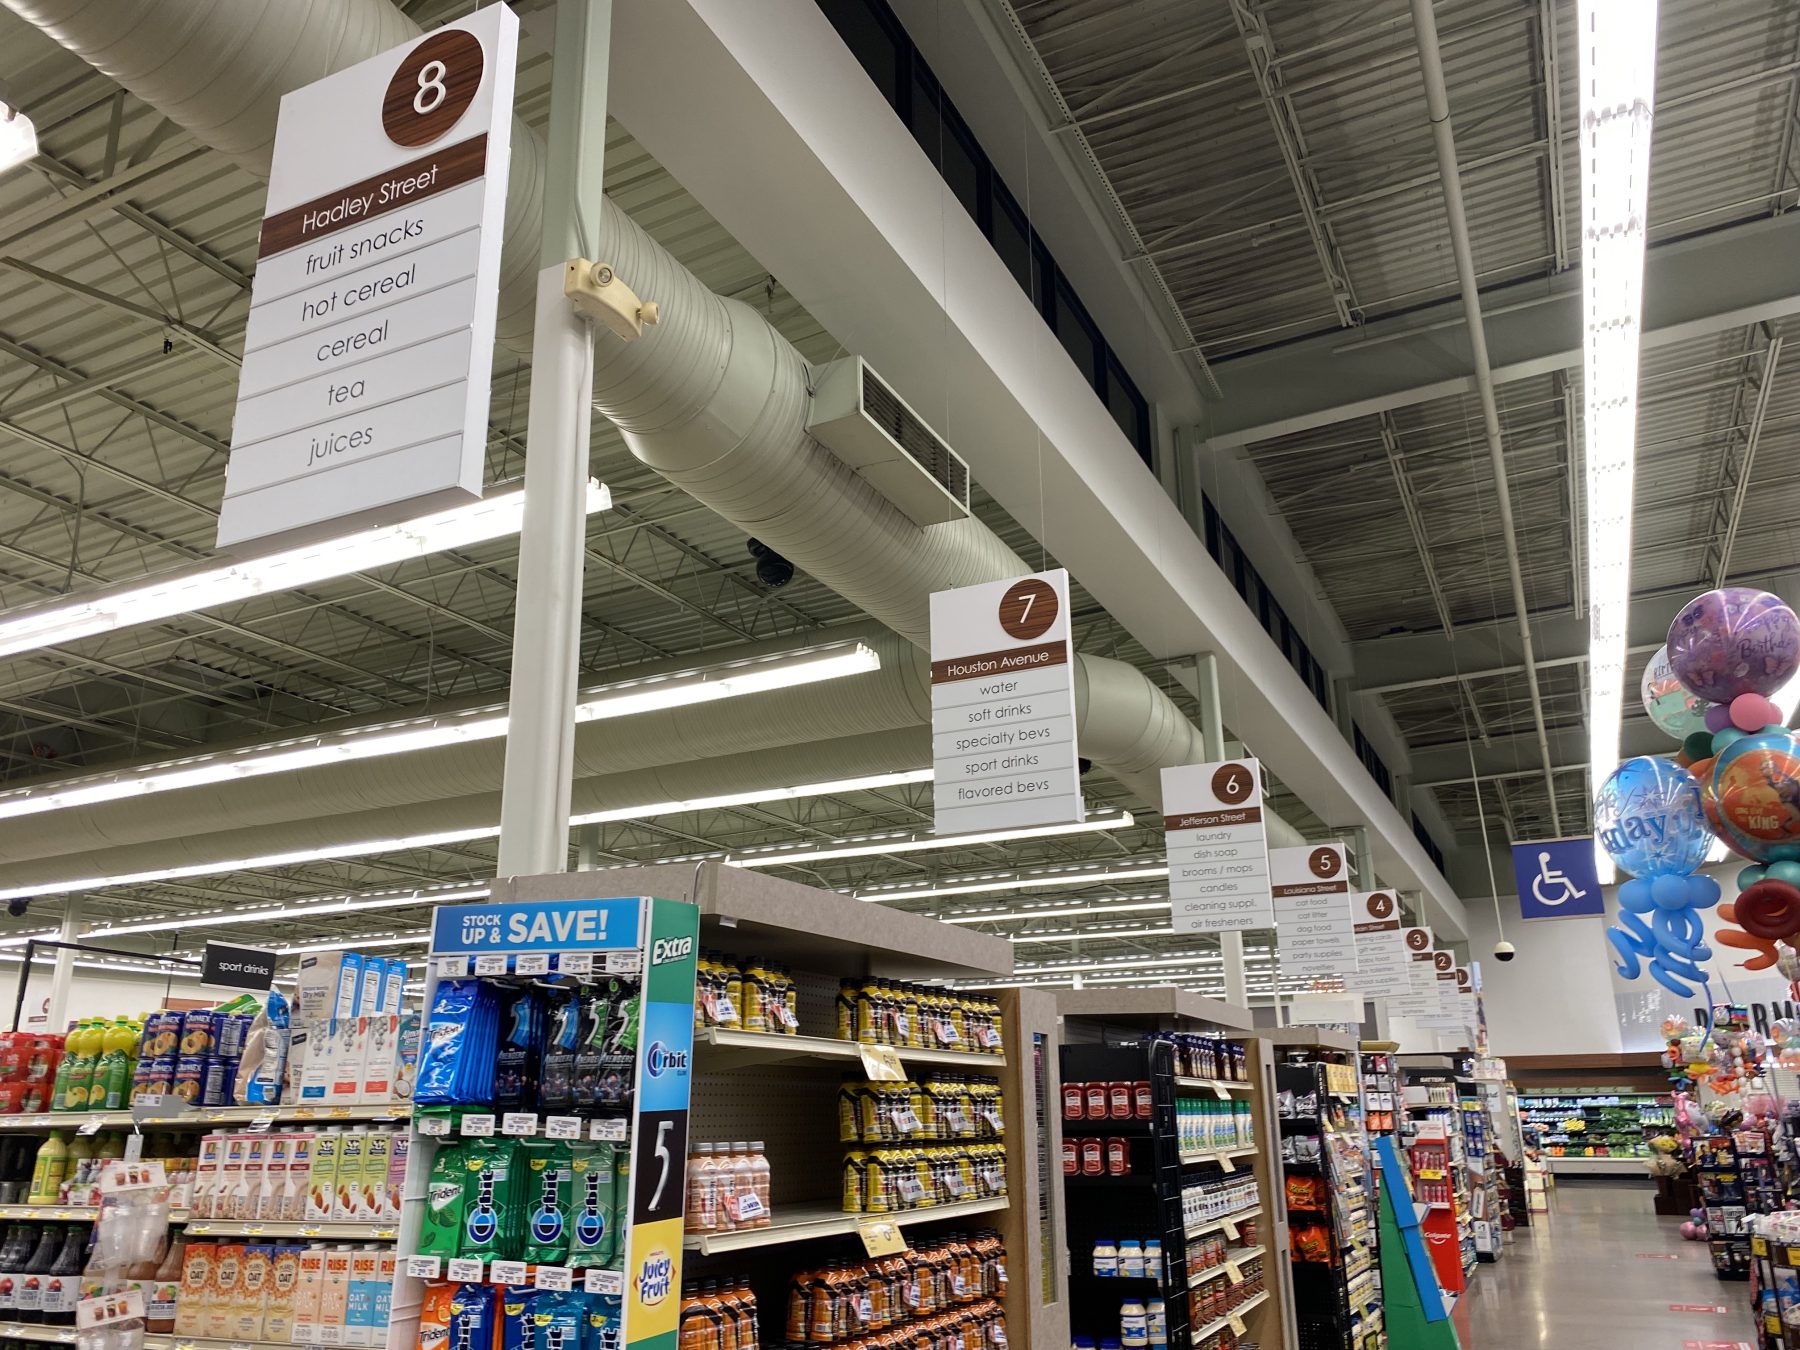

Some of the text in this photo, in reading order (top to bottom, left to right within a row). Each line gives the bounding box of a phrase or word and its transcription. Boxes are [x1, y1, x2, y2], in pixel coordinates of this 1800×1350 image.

[413, 60, 446, 115] 8
[302, 164, 439, 235] Hadley Street
[305, 218, 424, 275] fruit snacks
[302, 264, 416, 322] hot cereal
[316, 319, 389, 362] cereal
[328, 379, 365, 406] tea
[307, 426, 374, 467] juices
[1018, 593, 1037, 624] 7
[947, 650, 1050, 677] Houston Avenue
[979, 680, 1019, 696] water
[968, 703, 1032, 723] soft drinks
[956, 727, 1050, 751] specialty bevs
[965, 753, 1039, 775] sport drinks
[958, 778, 1050, 801] flavored bevs
[1226, 774, 1240, 795] 6
[1179, 813, 1246, 827] Jefferson Street
[1196, 831, 1231, 843] laundry
[1193, 849, 1238, 860] dish soap
[1320, 855, 1331, 871] 5
[1182, 866, 1217, 878] brooms
[1226, 864, 1253, 875] mops
[1199, 882, 1239, 894] candles
[1283, 885, 1337, 895] Louisiana Street
[1184, 901, 1227, 914] cleaning
[1310, 898, 1328, 906] food
[1375, 900, 1385, 912] 4
[463, 914, 501, 927] STOCK
[507, 909, 609, 944] SAVE!
[1191, 918, 1253, 929] air fresheners
[462, 927, 501, 944] UP &
[1297, 924, 1332, 934] dog food
[1292, 939, 1314, 947] paper
[1413, 934, 1422, 945] 3
[652, 936, 692, 966] Extra
[1293, 952, 1312, 960] party
[218, 961, 269, 976] sport drinks
[1438, 956, 1447, 967] 2
[647, 1041, 687, 1079] Orbit
[649, 1121, 673, 1211] 5
[428, 1184, 463, 1202] Trident
[467, 1169, 498, 1245] Orbit
[531, 1169, 564, 1244] Orbit
[576, 1170, 605, 1247] Orbit
[1424, 1231, 1451, 1240] Colgate
[301, 1258, 321, 1269] RISE
[327, 1259, 348, 1270] RISE
[353, 1259, 375, 1271] RISE
[381, 1260, 396, 1272] RIS
[189, 1271, 204, 1279] OAT
[221, 1271, 235, 1280] OAT
[247, 1272, 262, 1281] OAT
[279, 1274, 292, 1283] OAT
[639, 1258, 670, 1285] Juicy
[349, 1294, 365, 1302] OAT
[348, 1302, 368, 1311] MILK
[375, 1304, 390, 1312] MIL
